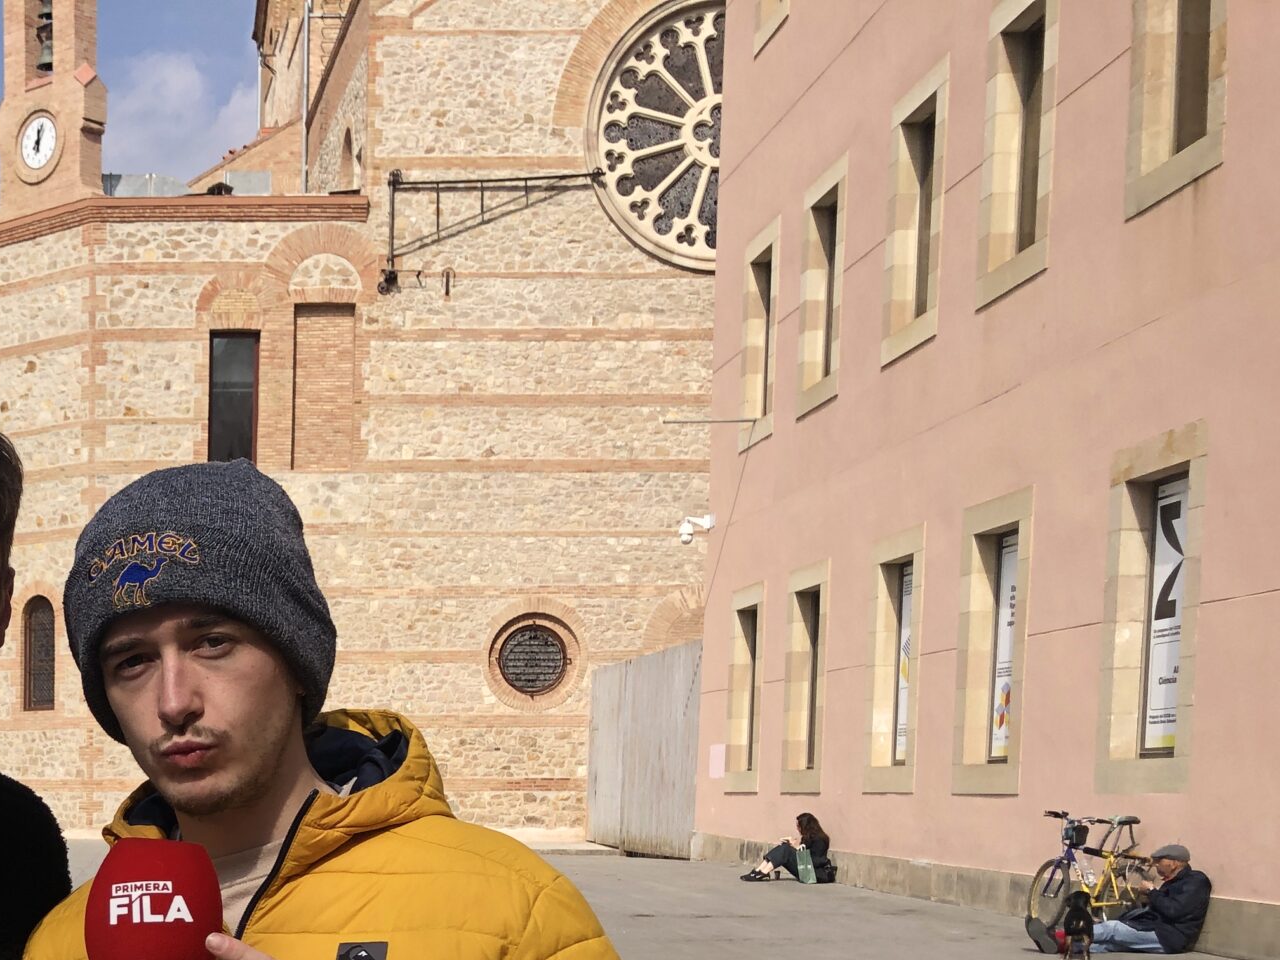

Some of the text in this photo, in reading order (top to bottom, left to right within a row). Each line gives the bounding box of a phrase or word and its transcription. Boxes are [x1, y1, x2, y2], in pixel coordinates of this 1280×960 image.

[87, 530, 201, 583] CAMEL
[114, 882, 170, 894] PRIMERA
[109, 894, 194, 925] FILA
